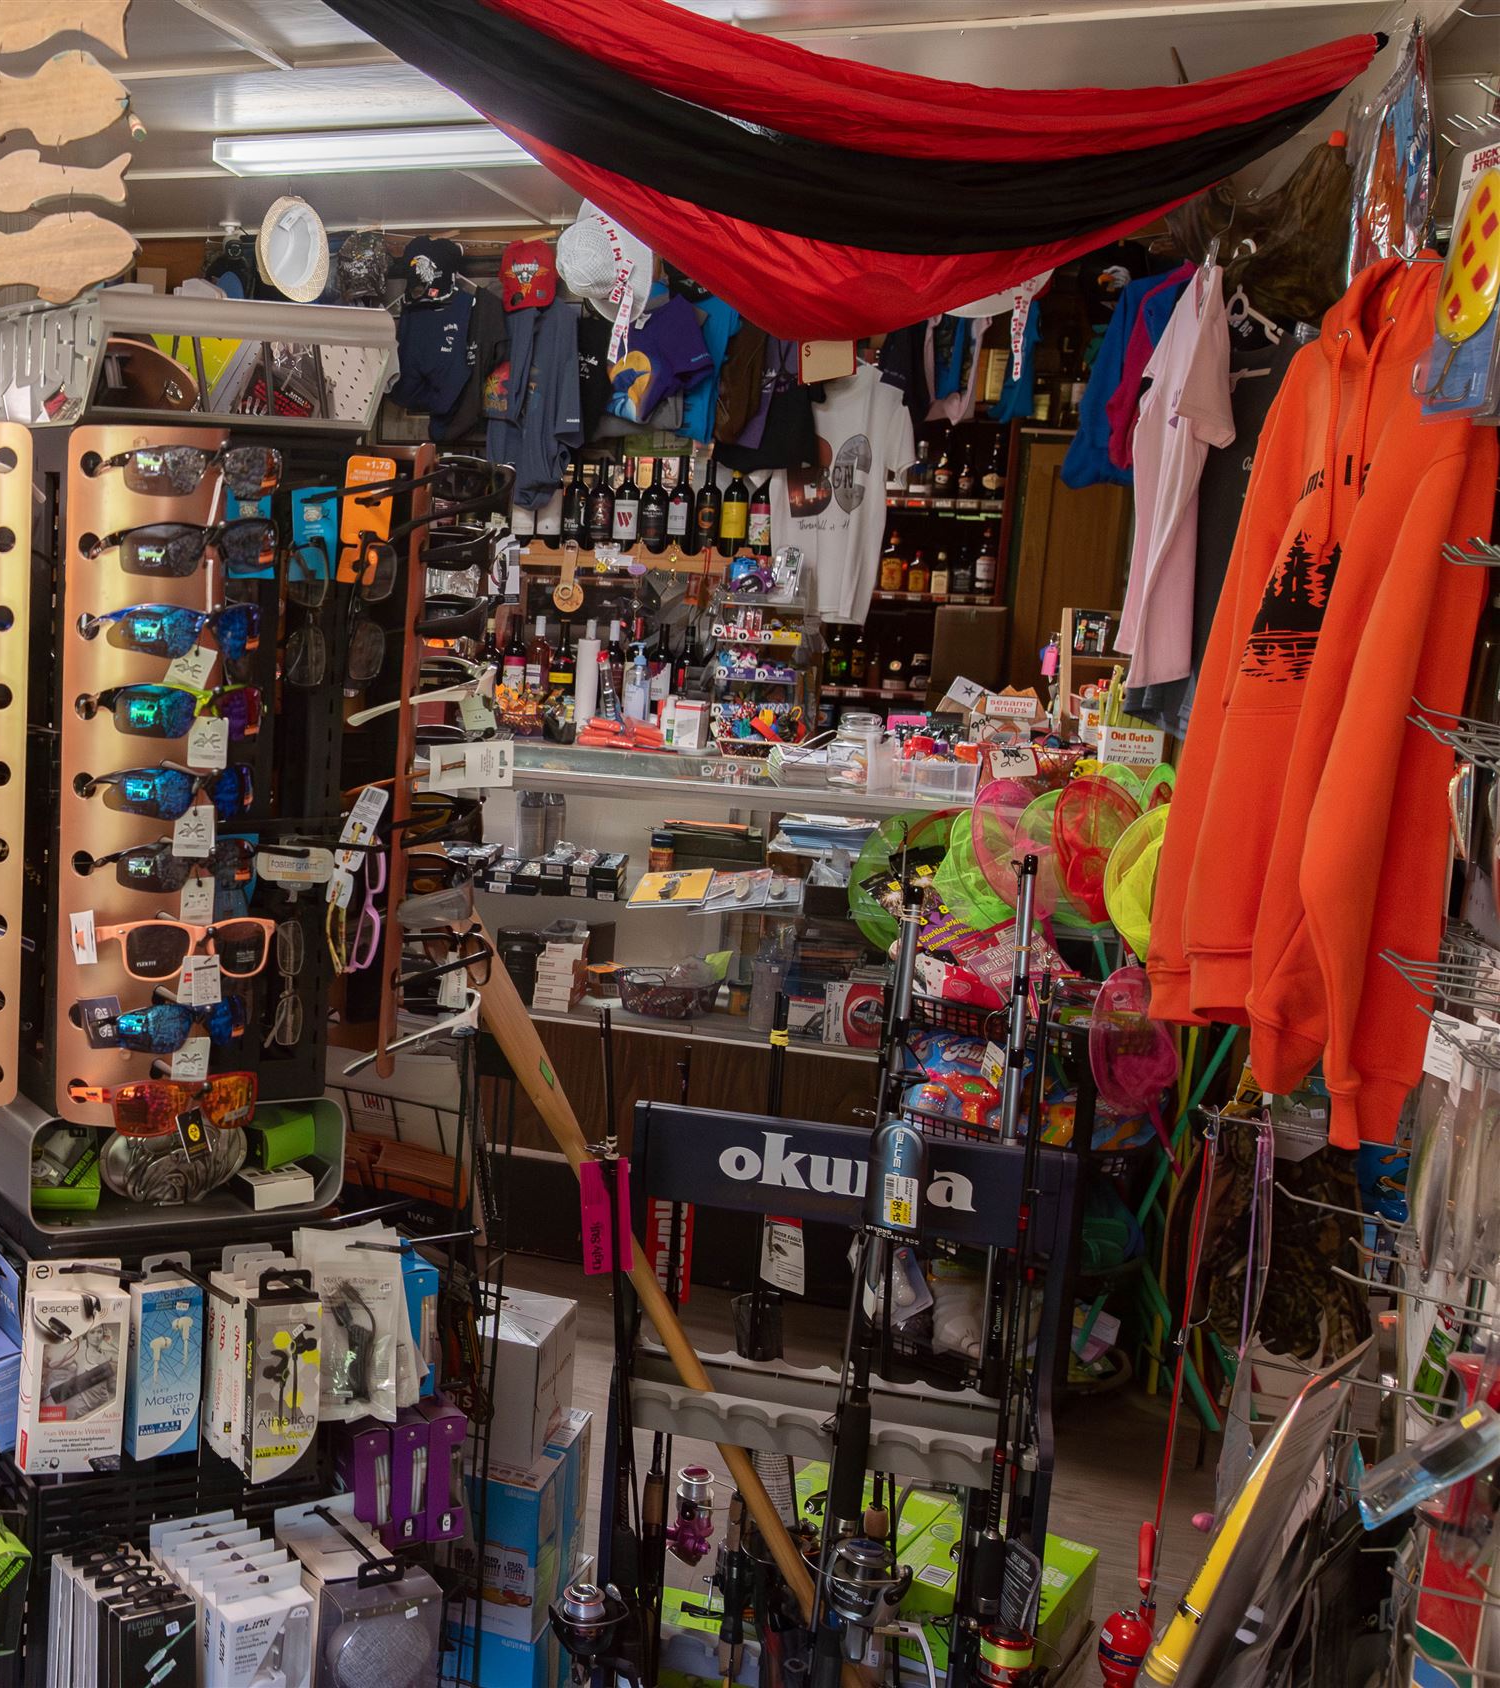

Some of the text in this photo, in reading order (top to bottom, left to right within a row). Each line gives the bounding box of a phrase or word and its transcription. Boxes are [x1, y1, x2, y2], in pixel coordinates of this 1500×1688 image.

[1474, 147, 1500, 162] LUCK
[804, 345, 811, 357] $
[990, 699, 1032, 708] sesame
[994, 706, 1027, 714] snaps
[1111, 731, 1154, 743] Old Dutch
[1000, 753, 1030, 768] 2.00
[1106, 754, 1157, 765] BEEF JERKY
[719, 1131, 977, 1213] okua
[144, 1393, 195, 1407] Maestro
[257, 1414, 315, 1429] Athletica
[0, 1559, 25, 1588] CHARGER
[126, 1615, 164, 1632] FLOWING
[137, 1627, 154, 1638] LED
